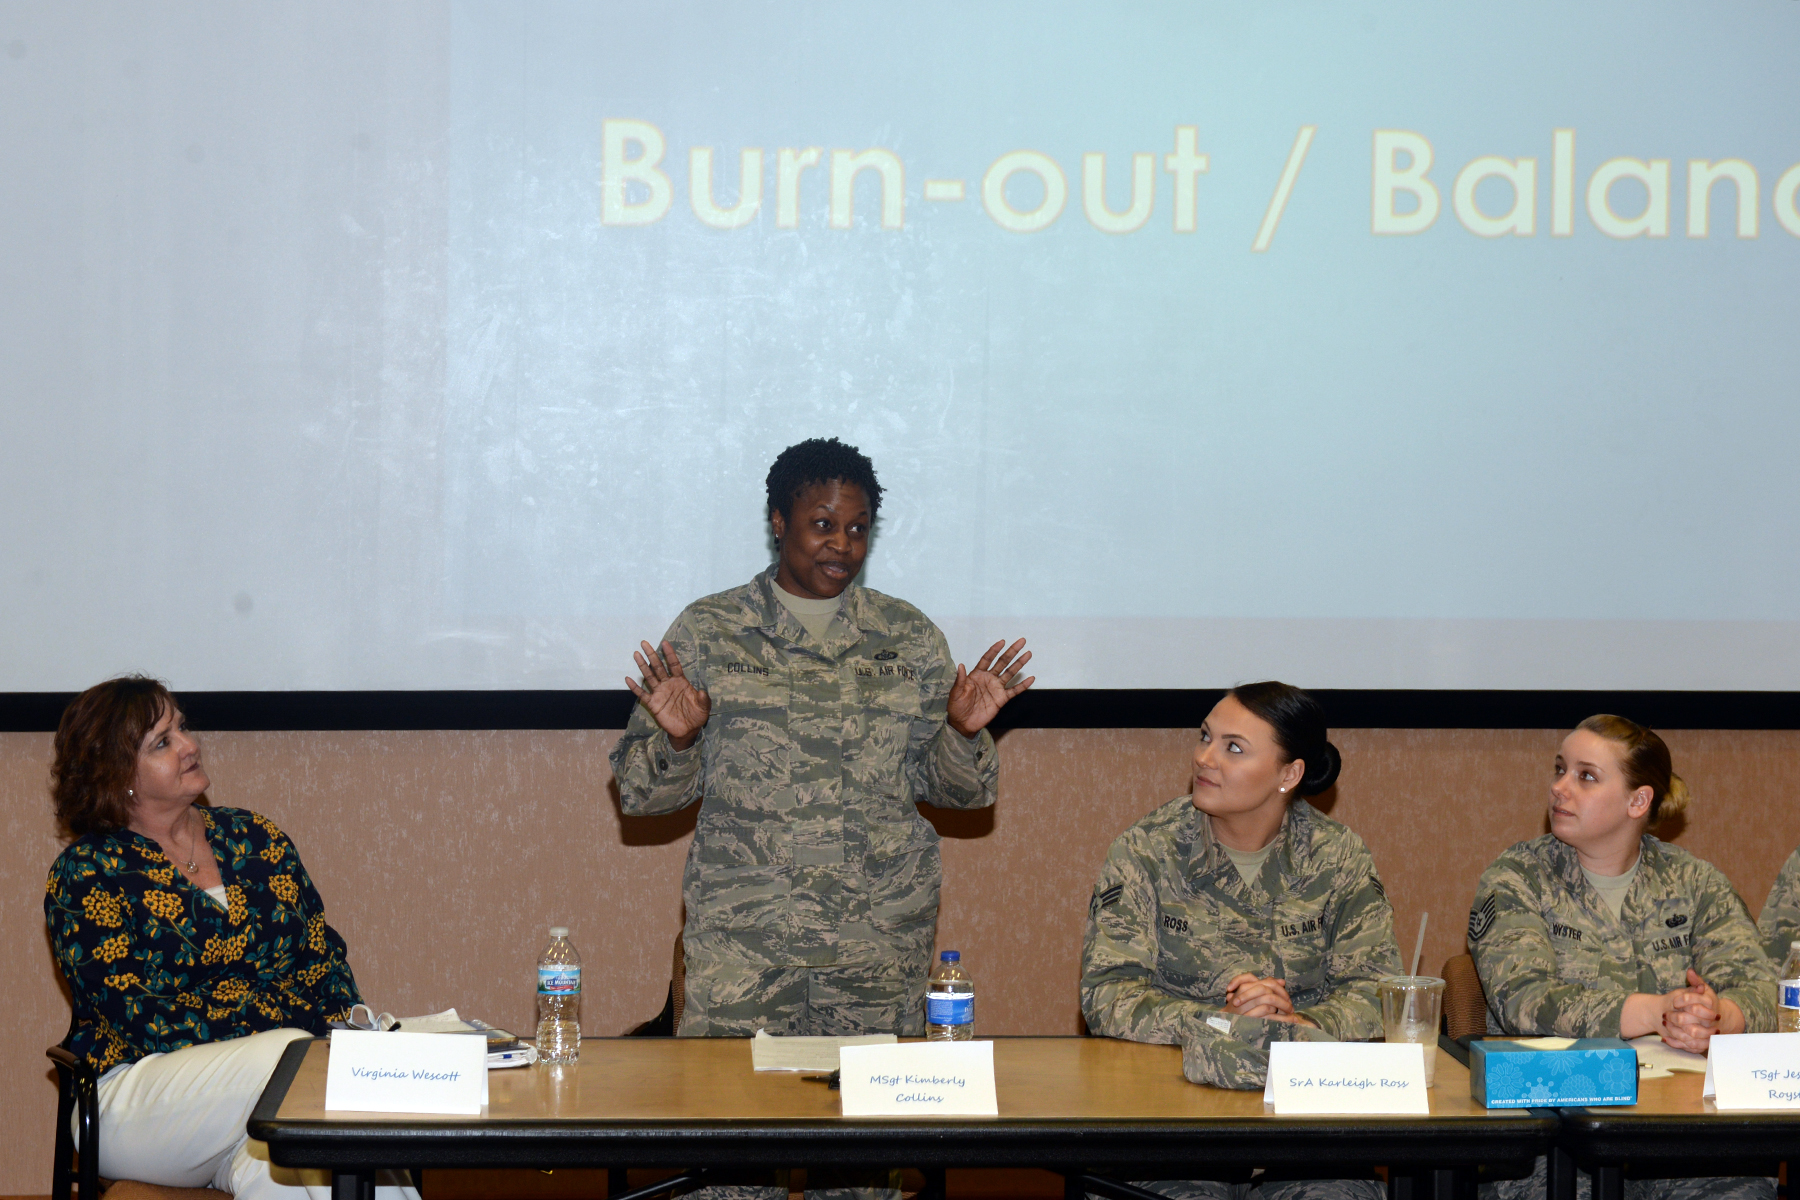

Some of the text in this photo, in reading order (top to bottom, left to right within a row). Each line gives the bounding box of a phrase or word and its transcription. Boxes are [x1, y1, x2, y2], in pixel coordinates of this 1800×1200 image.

[601, 118, 1210, 234] Burn-out
[1250, 125, 1317, 253] /
[727, 662, 769, 677] COLLINS
[855, 666, 876, 677] U.S.
[879, 665, 894, 676] AIR
[1164, 916, 1188, 932] ROSS
[1281, 924, 1299, 937] U.S.
[1302, 919, 1316, 934] AIR
[1669, 935, 1683, 949] AIR
[351, 1067, 461, 1081] Virginia Wescott
[869, 1074, 966, 1088] MSgt Kimberly
[1751, 1069, 1780, 1081] TSgt
[1289, 1078, 1410, 1090] SrA Karleigh Ross
[895, 1093, 944, 1103] Collins
